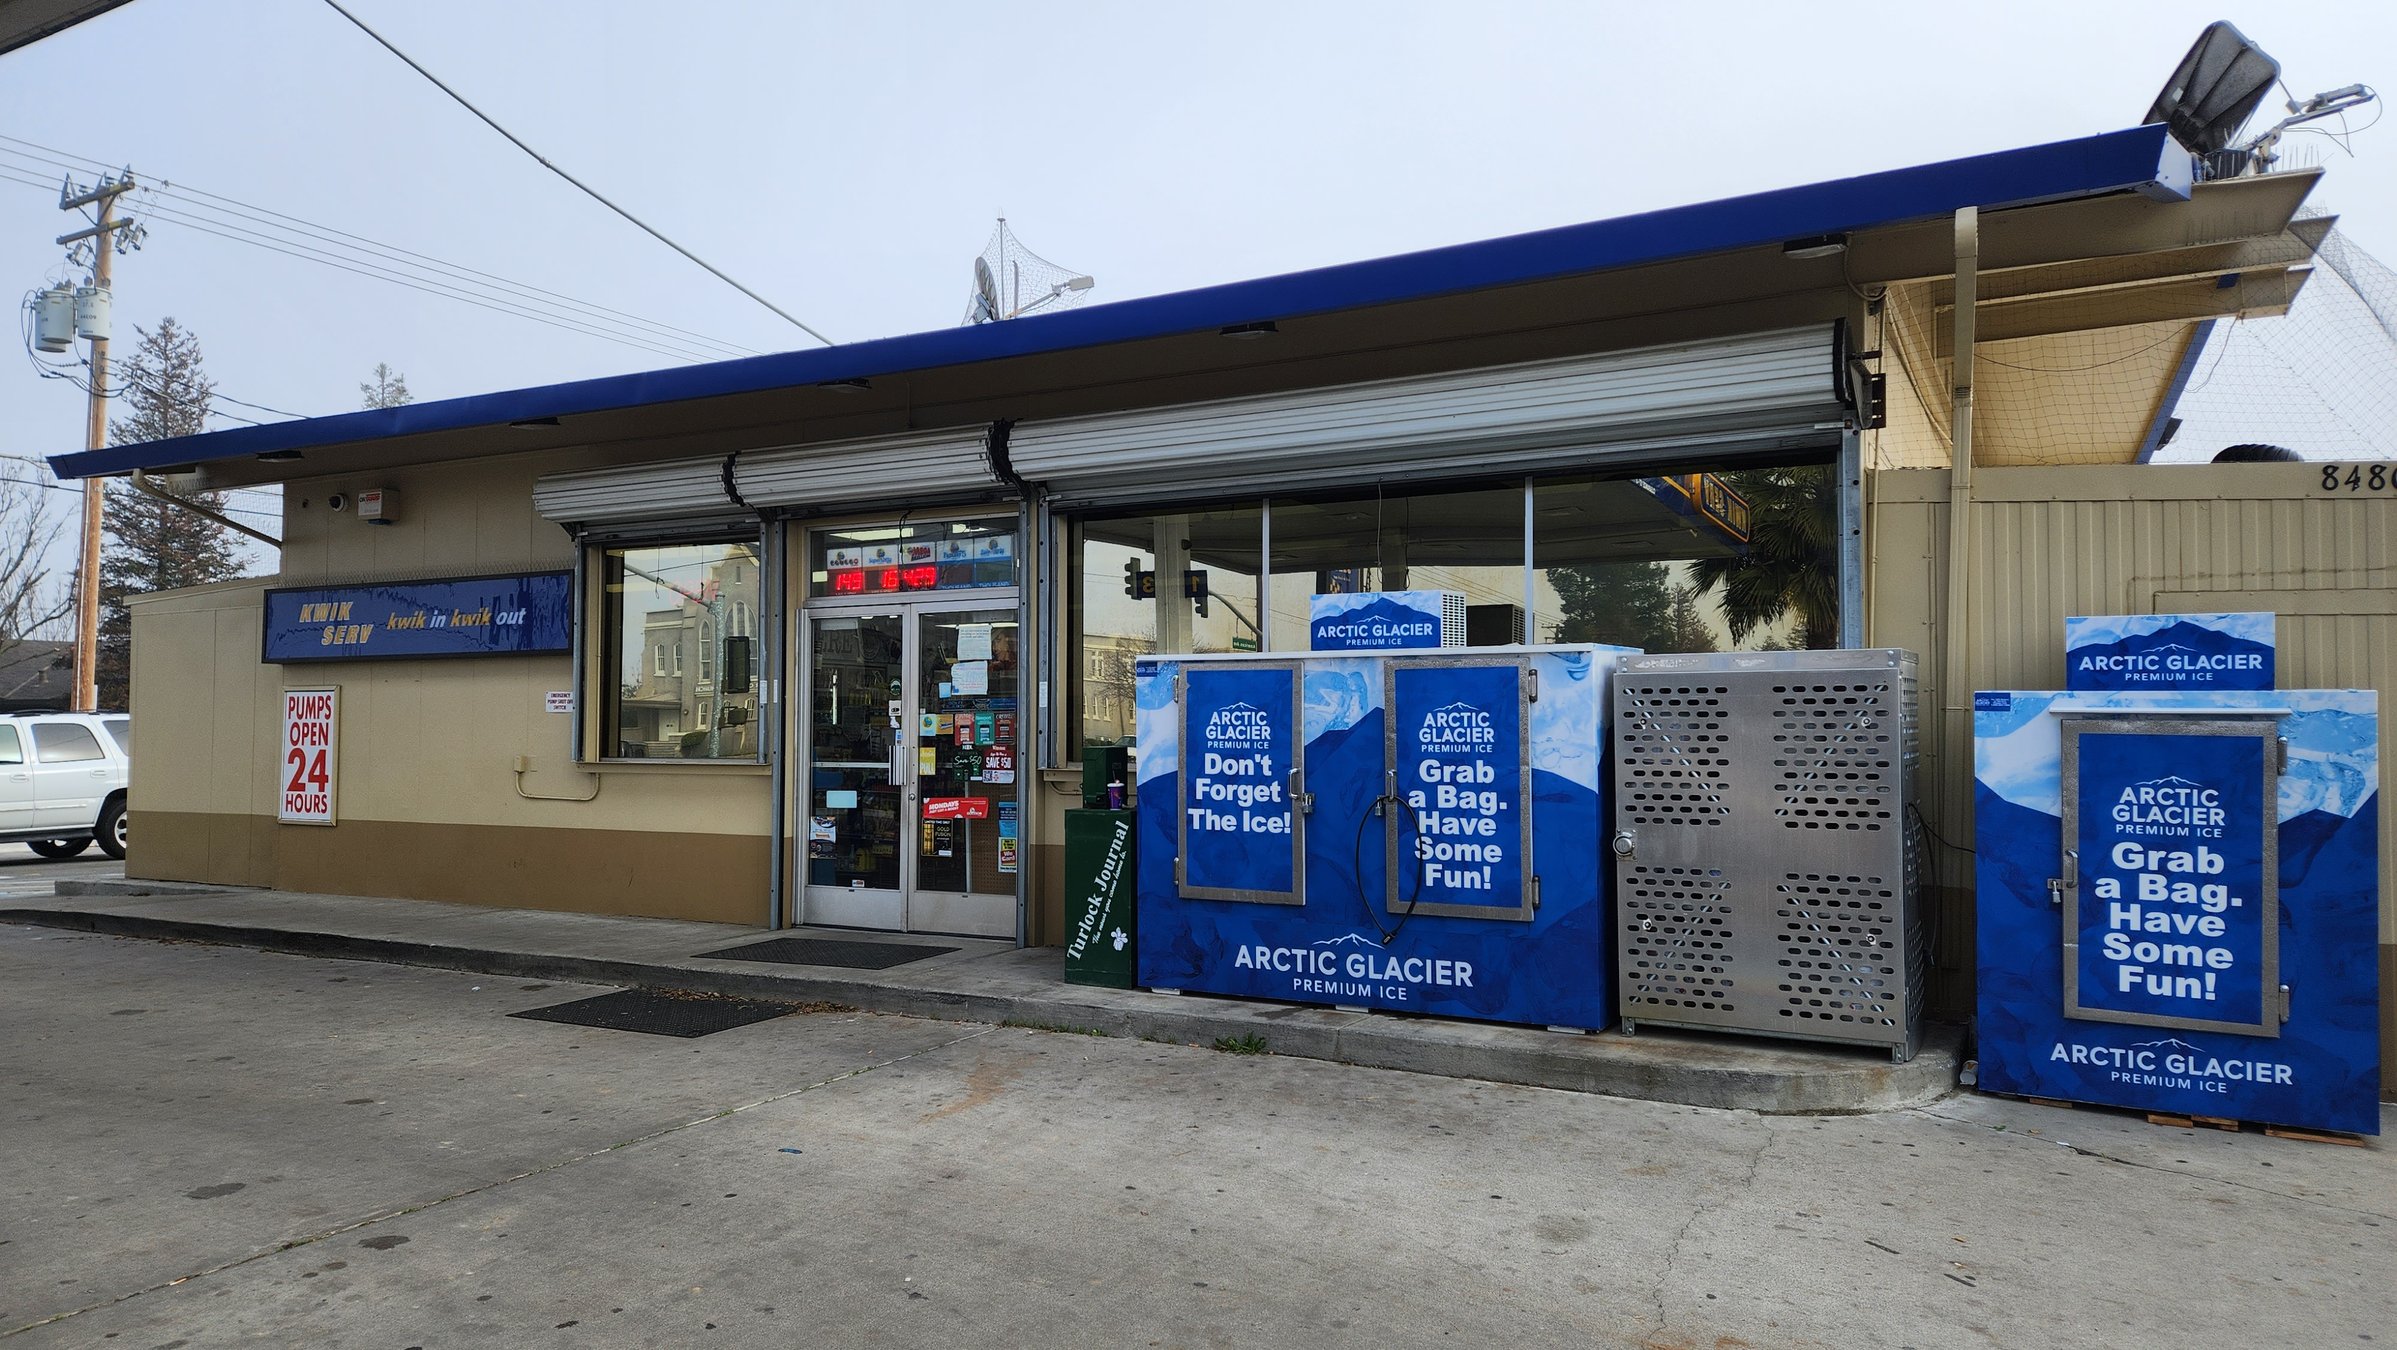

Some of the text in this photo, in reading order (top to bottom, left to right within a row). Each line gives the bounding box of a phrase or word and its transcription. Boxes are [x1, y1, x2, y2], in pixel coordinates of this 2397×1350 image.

[300, 601, 353, 623] KWIK
[386, 607, 527, 630] kwik in kwik out
[322, 624, 374, 646] SERV
[1318, 623, 1433, 638] ARCTIC GLACIER
[1346, 638, 1402, 646] PREMIUM ICE
[2079, 654, 2263, 671] ARCTIC GLACIER
[2124, 672, 2214, 681] PREMIUM ICE
[288, 695, 332, 720] PUMPS
[1210, 711, 1267, 726] ARCTIC
[1423, 712, 1490, 728] ARCTIC
[290, 722, 329, 746] OPEN
[1206, 726, 1271, 740] GLACIER
[1208, 740, 1270, 750] PREMIUM ICE
[1418, 728, 1495, 743] GLACIER
[1421, 744, 1493, 753] PREMIUM ICE
[286, 748, 328, 792] 24
[986, 757, 1012, 768] SAVE $50
[1204, 752, 1272, 776] Don't
[1418, 758, 1495, 784] Grab
[286, 794, 328, 814] HOURS
[1196, 778, 1281, 808] Forget
[1408, 785, 1508, 816] a Bag.
[2118, 786, 2219, 807] ARCTIC
[1188, 808, 1291, 834] The Ice!
[1418, 811, 1496, 836] Have
[2112, 804, 2226, 826] GLACIER
[2116, 824, 2222, 838] PREMIUM ICE
[1414, 836, 1502, 864] Some
[2111, 841, 2224, 875] Grab
[1425, 863, 1492, 890] Fun!
[1066, 820, 1130, 960] Turlock Journal
[2094, 873, 2243, 913] a Bag.
[2109, 902, 2226, 938] Have
[2102, 932, 2234, 970] Some
[1234, 944, 1474, 988] ARCTIC GLACIER
[1293, 978, 1408, 1000] PREMIUM ICE
[2118, 965, 2216, 1000] Fun!
[2050, 1042, 2294, 1086] ARCTIC GLACIER
[2111, 1070, 2228, 1094] PREMIUM ICE
